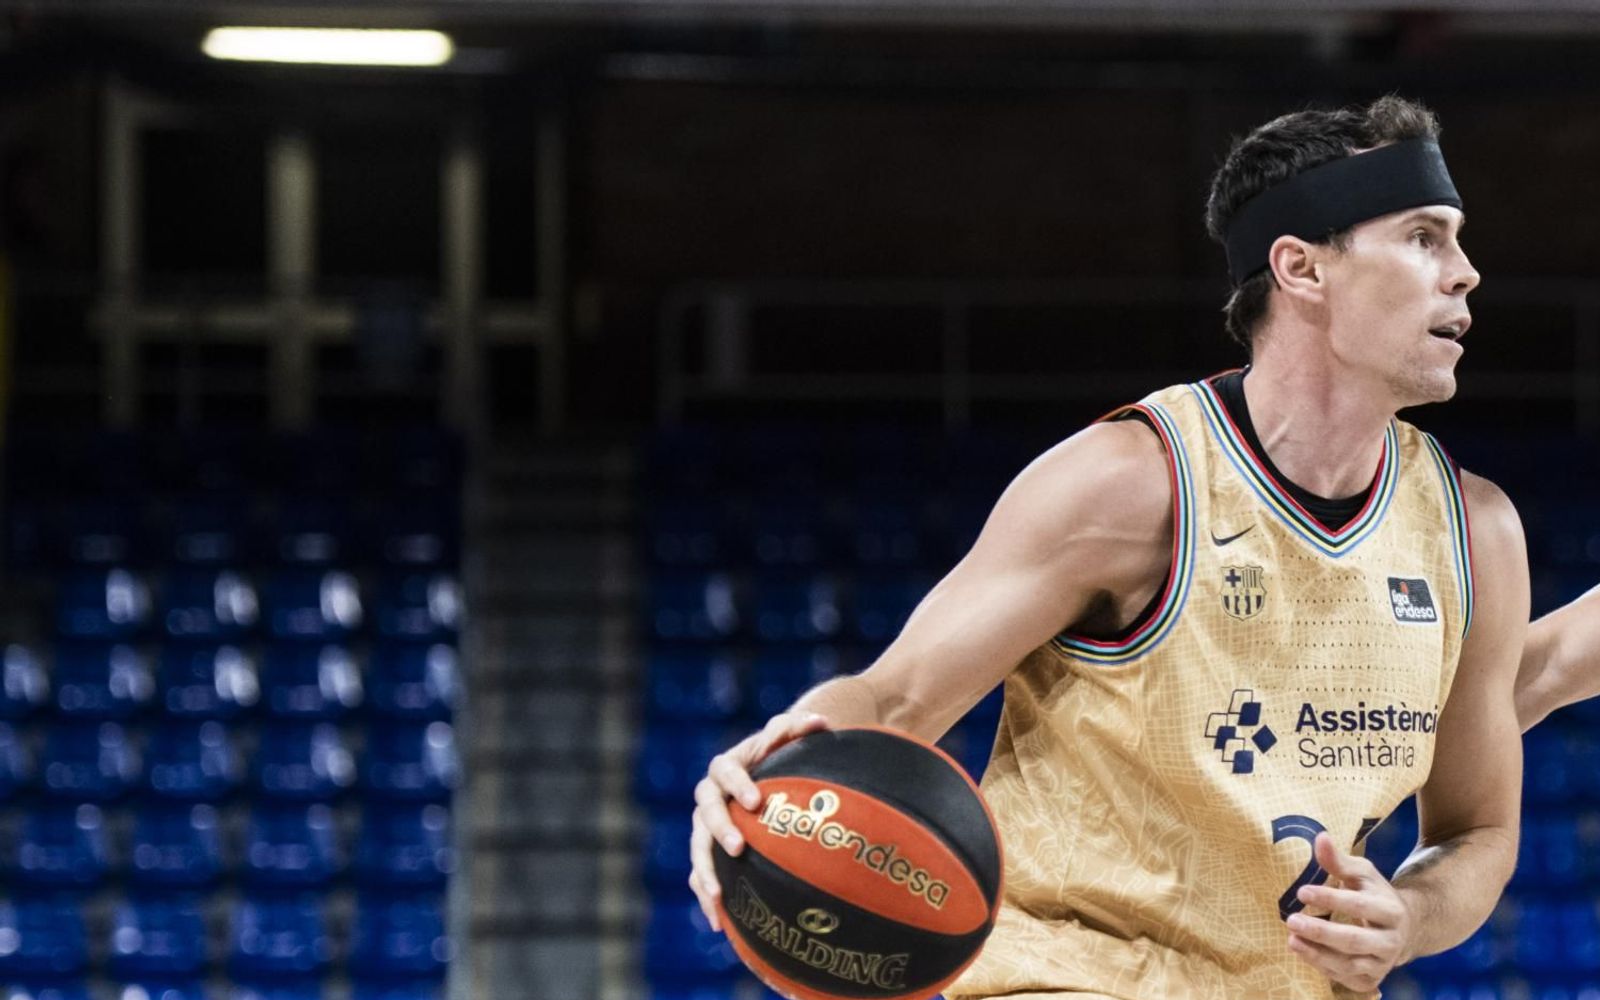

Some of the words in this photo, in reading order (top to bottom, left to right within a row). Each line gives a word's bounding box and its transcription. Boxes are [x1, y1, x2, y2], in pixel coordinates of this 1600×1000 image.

[1395, 603, 1436, 619] endesa
[1295, 702, 1438, 734] Assistènci
[1298, 738, 1415, 768] Sanitària
[819, 822, 950, 910] endesa
[729, 876, 910, 988] SPALDING
